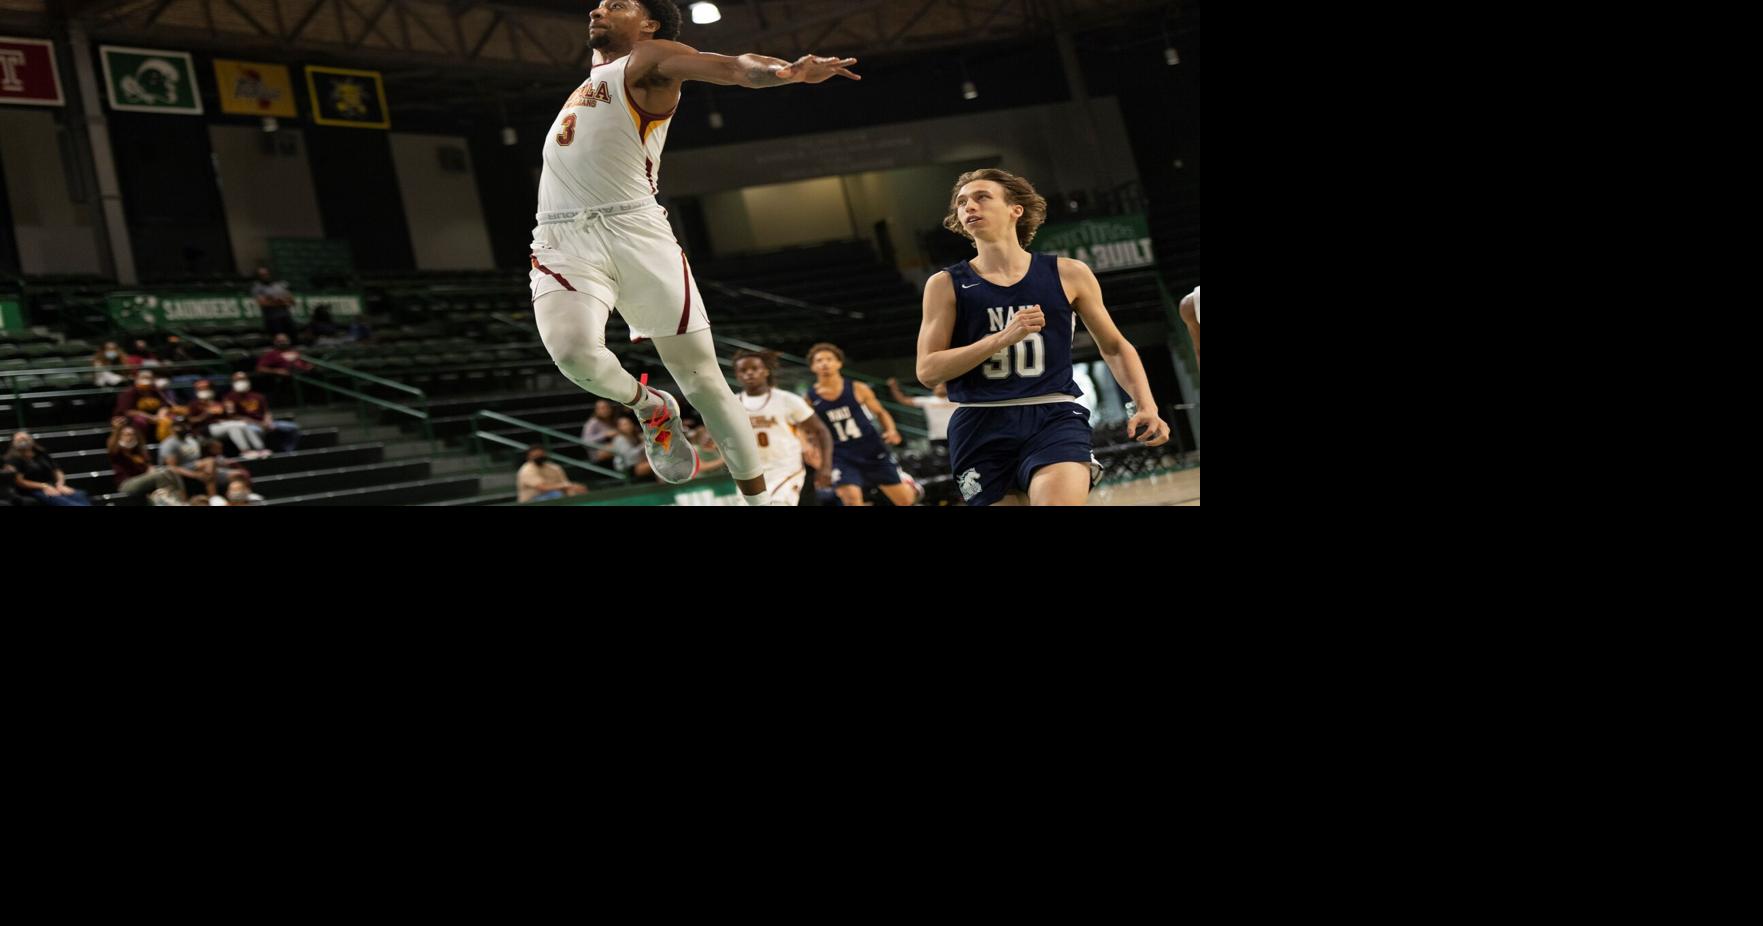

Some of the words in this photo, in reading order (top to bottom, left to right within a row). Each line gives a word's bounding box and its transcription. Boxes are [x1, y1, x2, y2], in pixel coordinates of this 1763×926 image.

[556, 113, 577, 146] 3
[987, 305, 1036, 332] NA
[833, 418, 862, 442] 14
